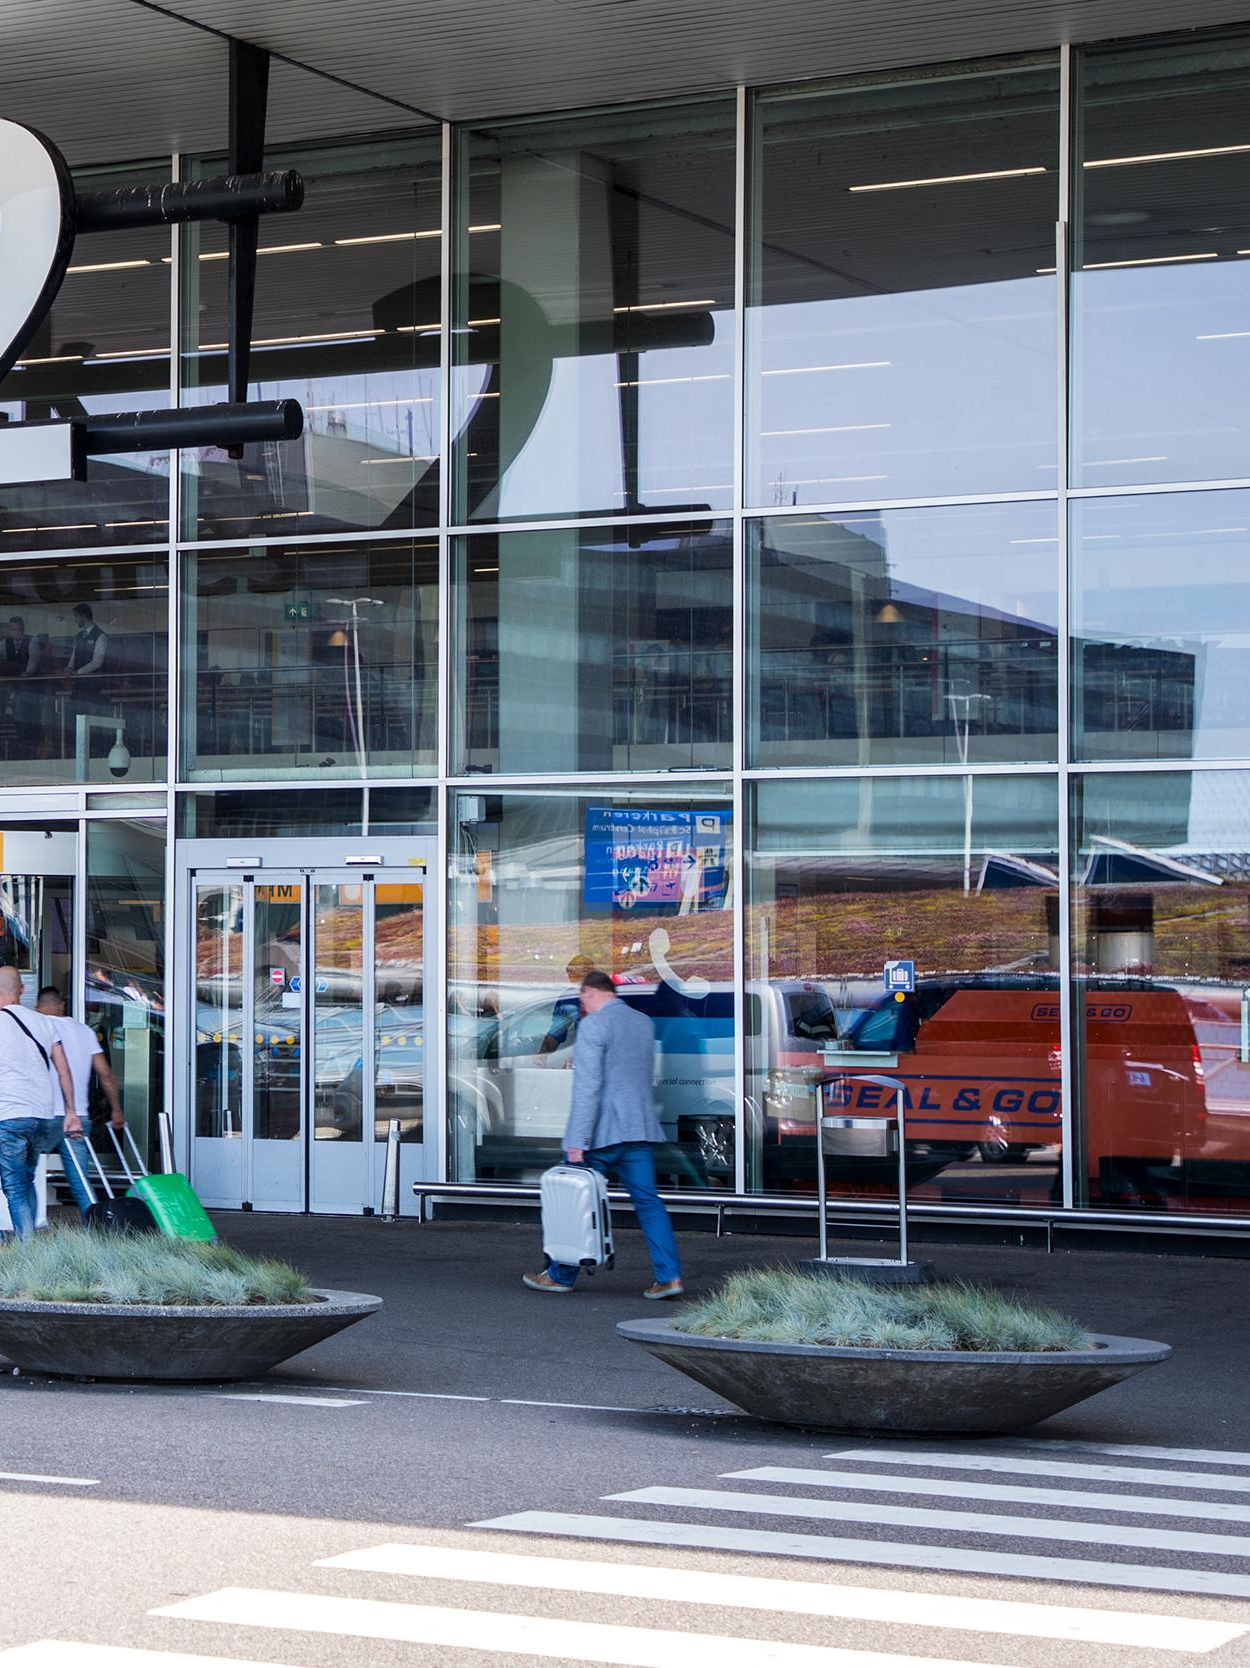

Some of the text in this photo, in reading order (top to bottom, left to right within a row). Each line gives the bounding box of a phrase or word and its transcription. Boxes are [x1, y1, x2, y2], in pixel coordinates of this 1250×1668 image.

[1037, 1007, 1061, 1017] SE
[1100, 1008, 1125, 1017] GO
[828, 1084, 1061, 1114] SEAL & GO
